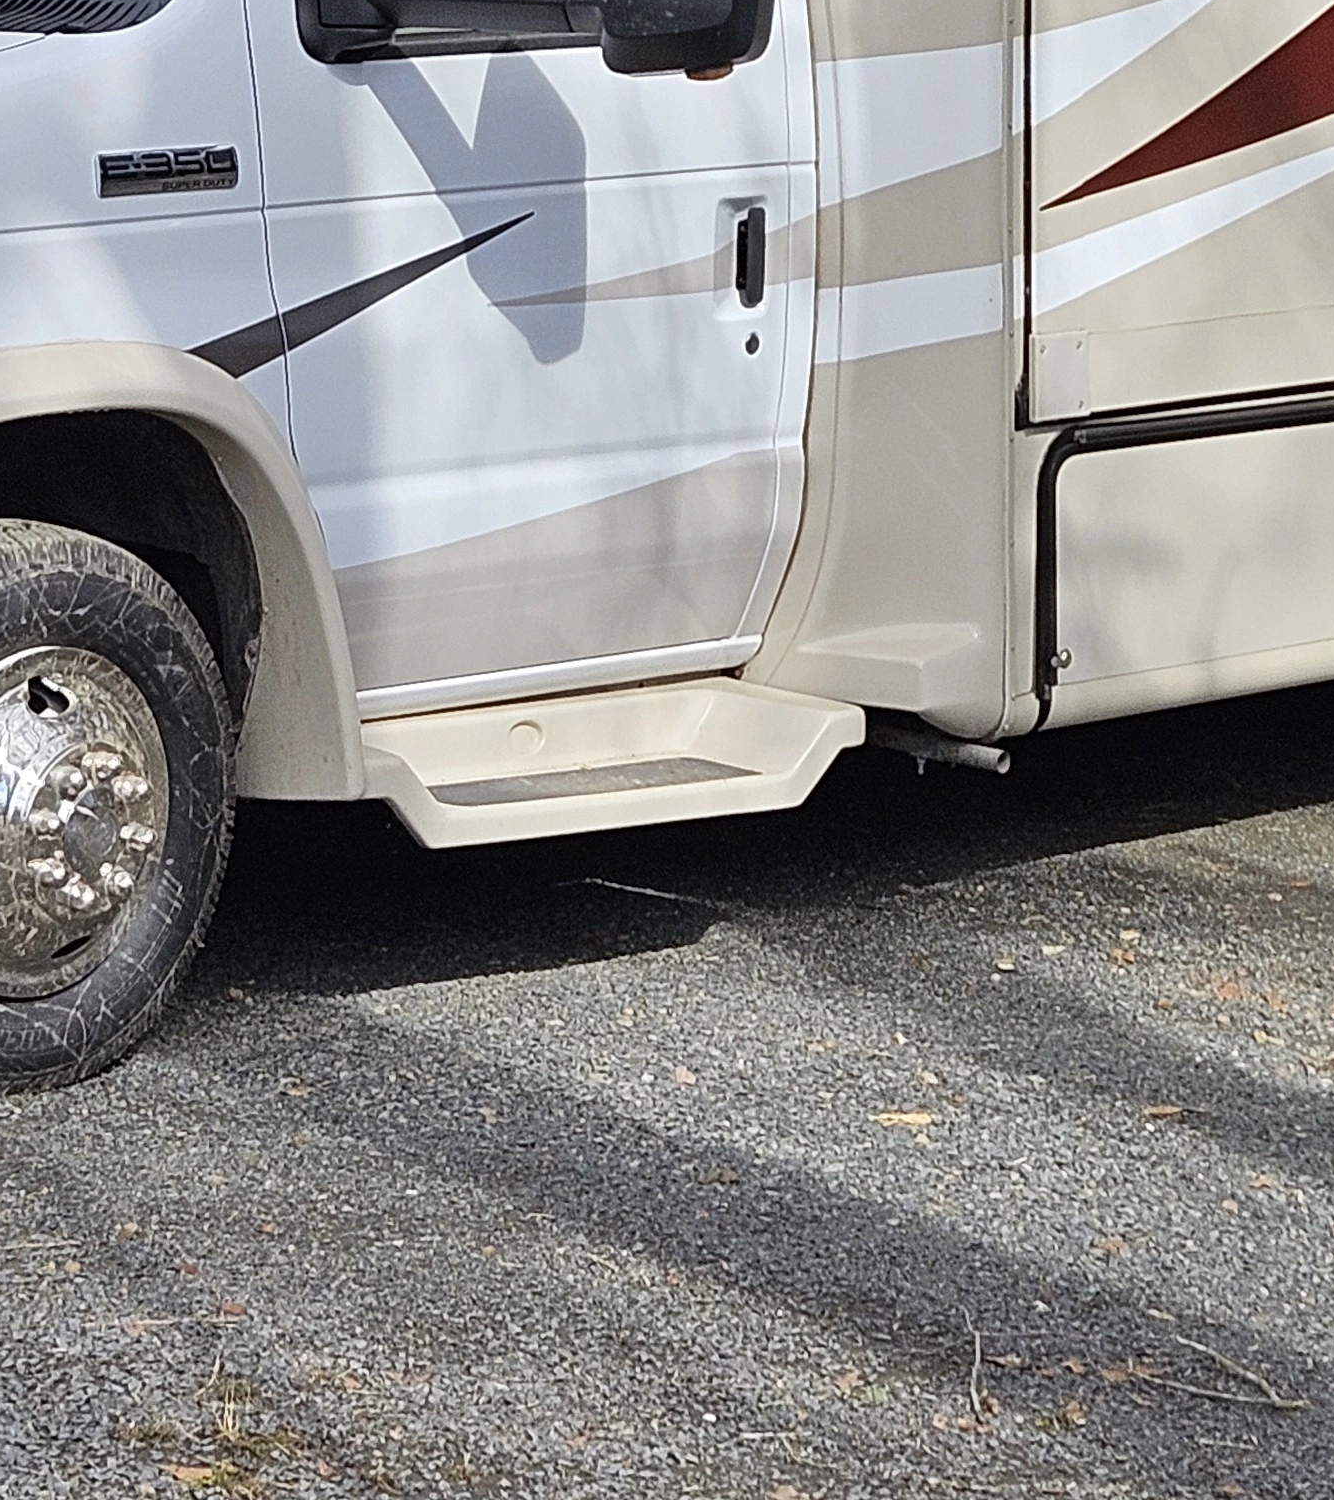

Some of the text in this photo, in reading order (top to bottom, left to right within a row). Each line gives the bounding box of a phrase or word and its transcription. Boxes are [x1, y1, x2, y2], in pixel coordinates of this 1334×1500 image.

[100, 148, 238, 179] E-350
[162, 179, 235, 191] SUPER DUTY
